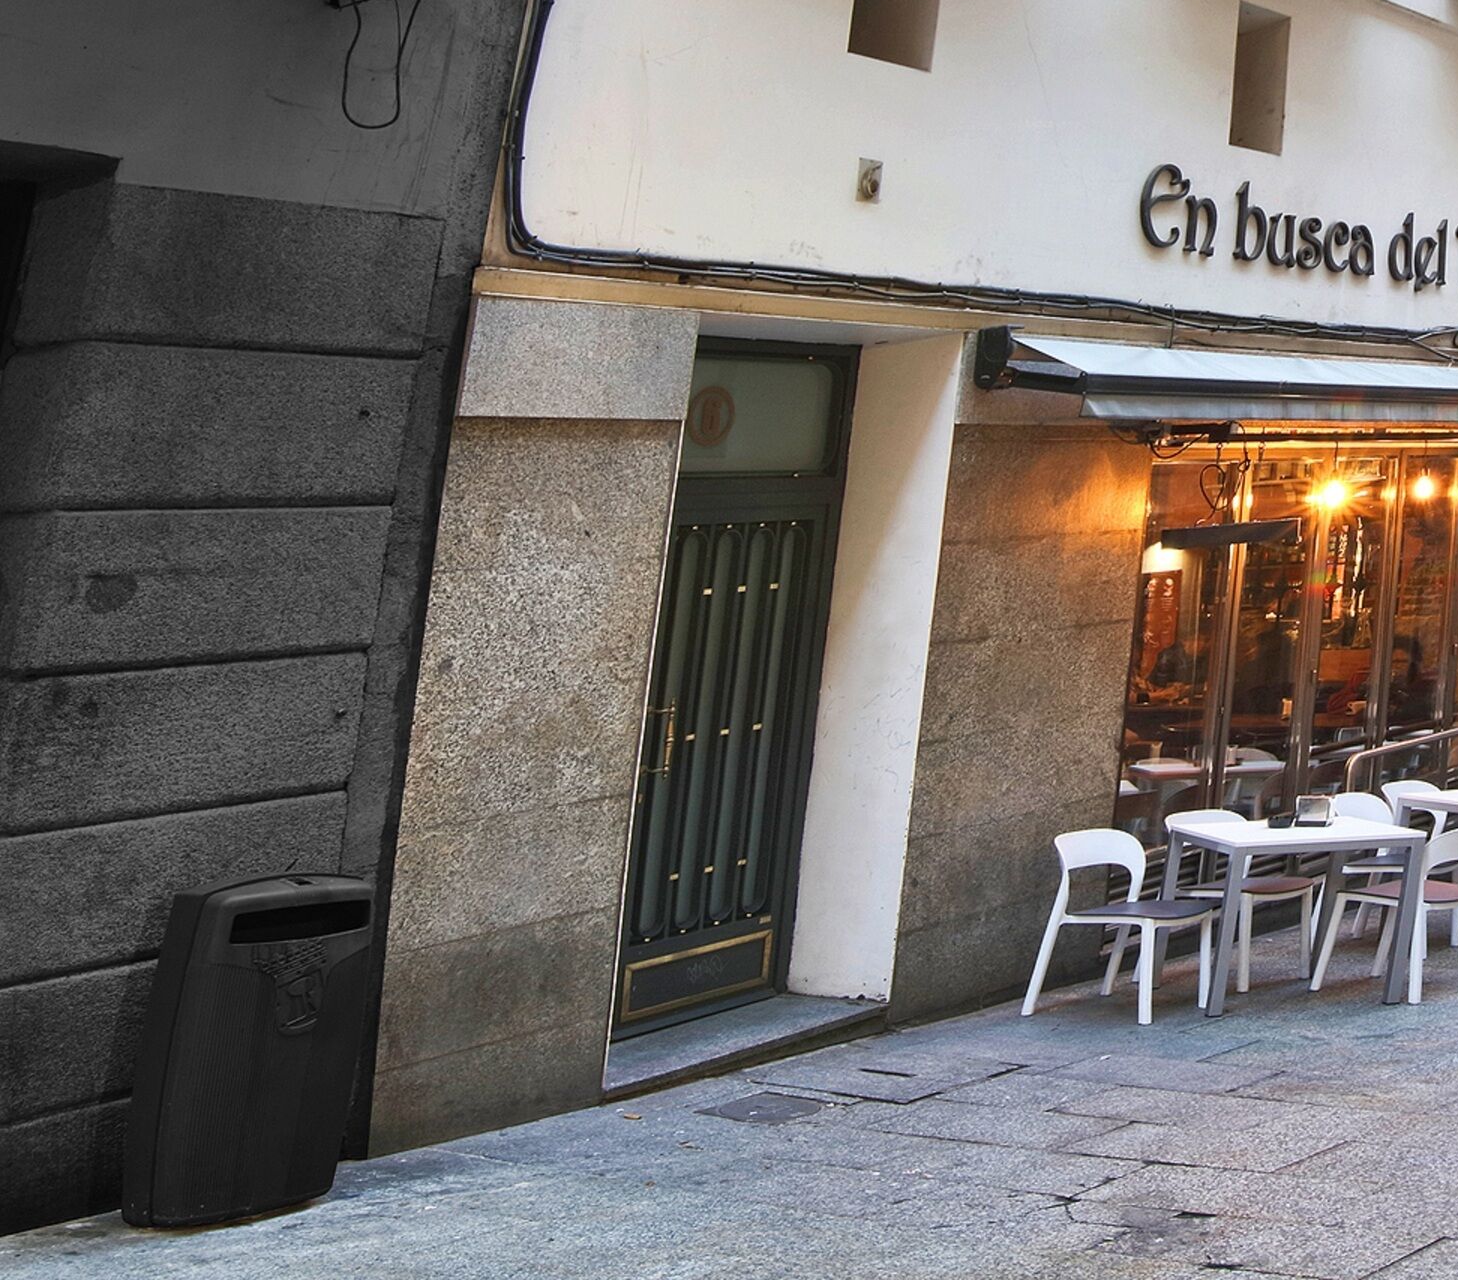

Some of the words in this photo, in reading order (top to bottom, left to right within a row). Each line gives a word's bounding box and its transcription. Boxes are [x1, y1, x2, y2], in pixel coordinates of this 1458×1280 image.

[1140, 163, 1218, 257] En
[1232, 181, 1375, 277] busca
[1388, 212, 1449, 292] del
